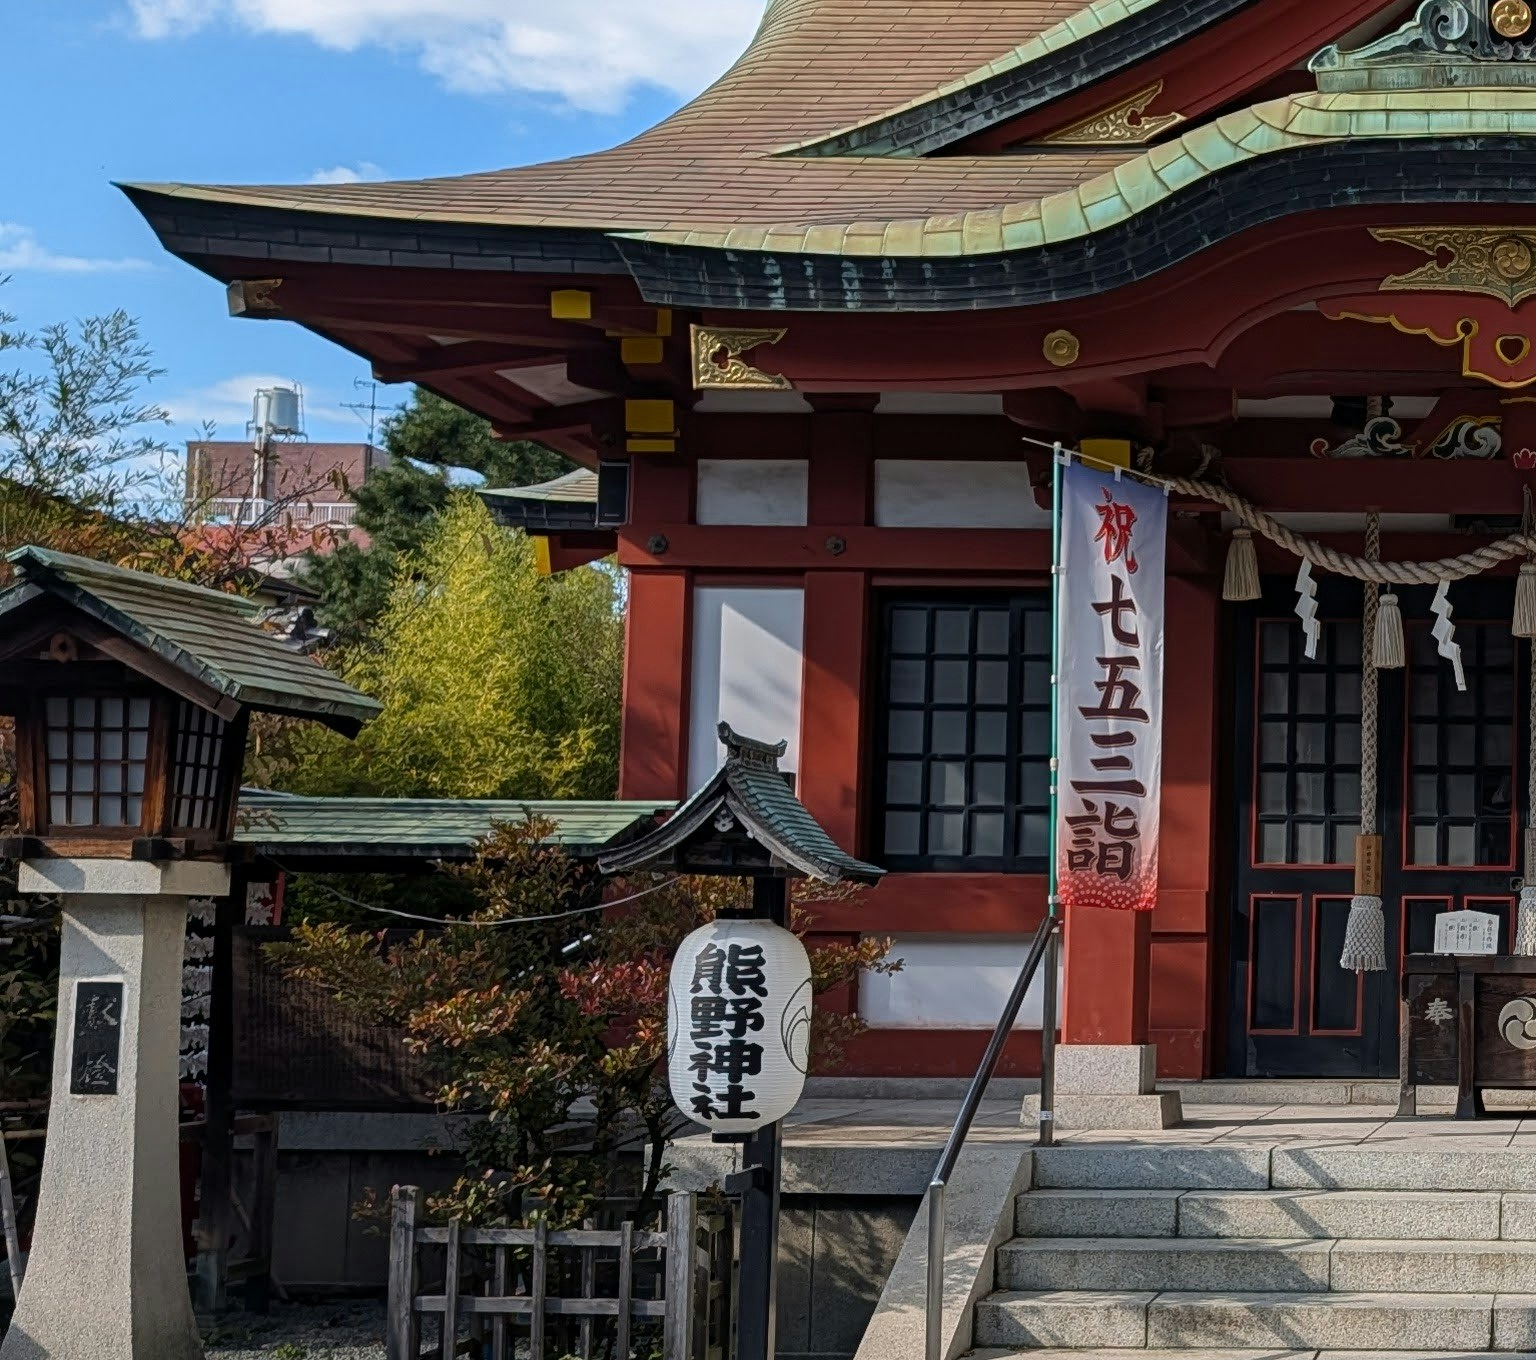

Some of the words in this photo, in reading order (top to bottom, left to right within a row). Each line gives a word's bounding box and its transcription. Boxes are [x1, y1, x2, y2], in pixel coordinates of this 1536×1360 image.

[687, 942, 769, 1120] 熊野神社
[1424, 997, 1454, 1026] 奉
